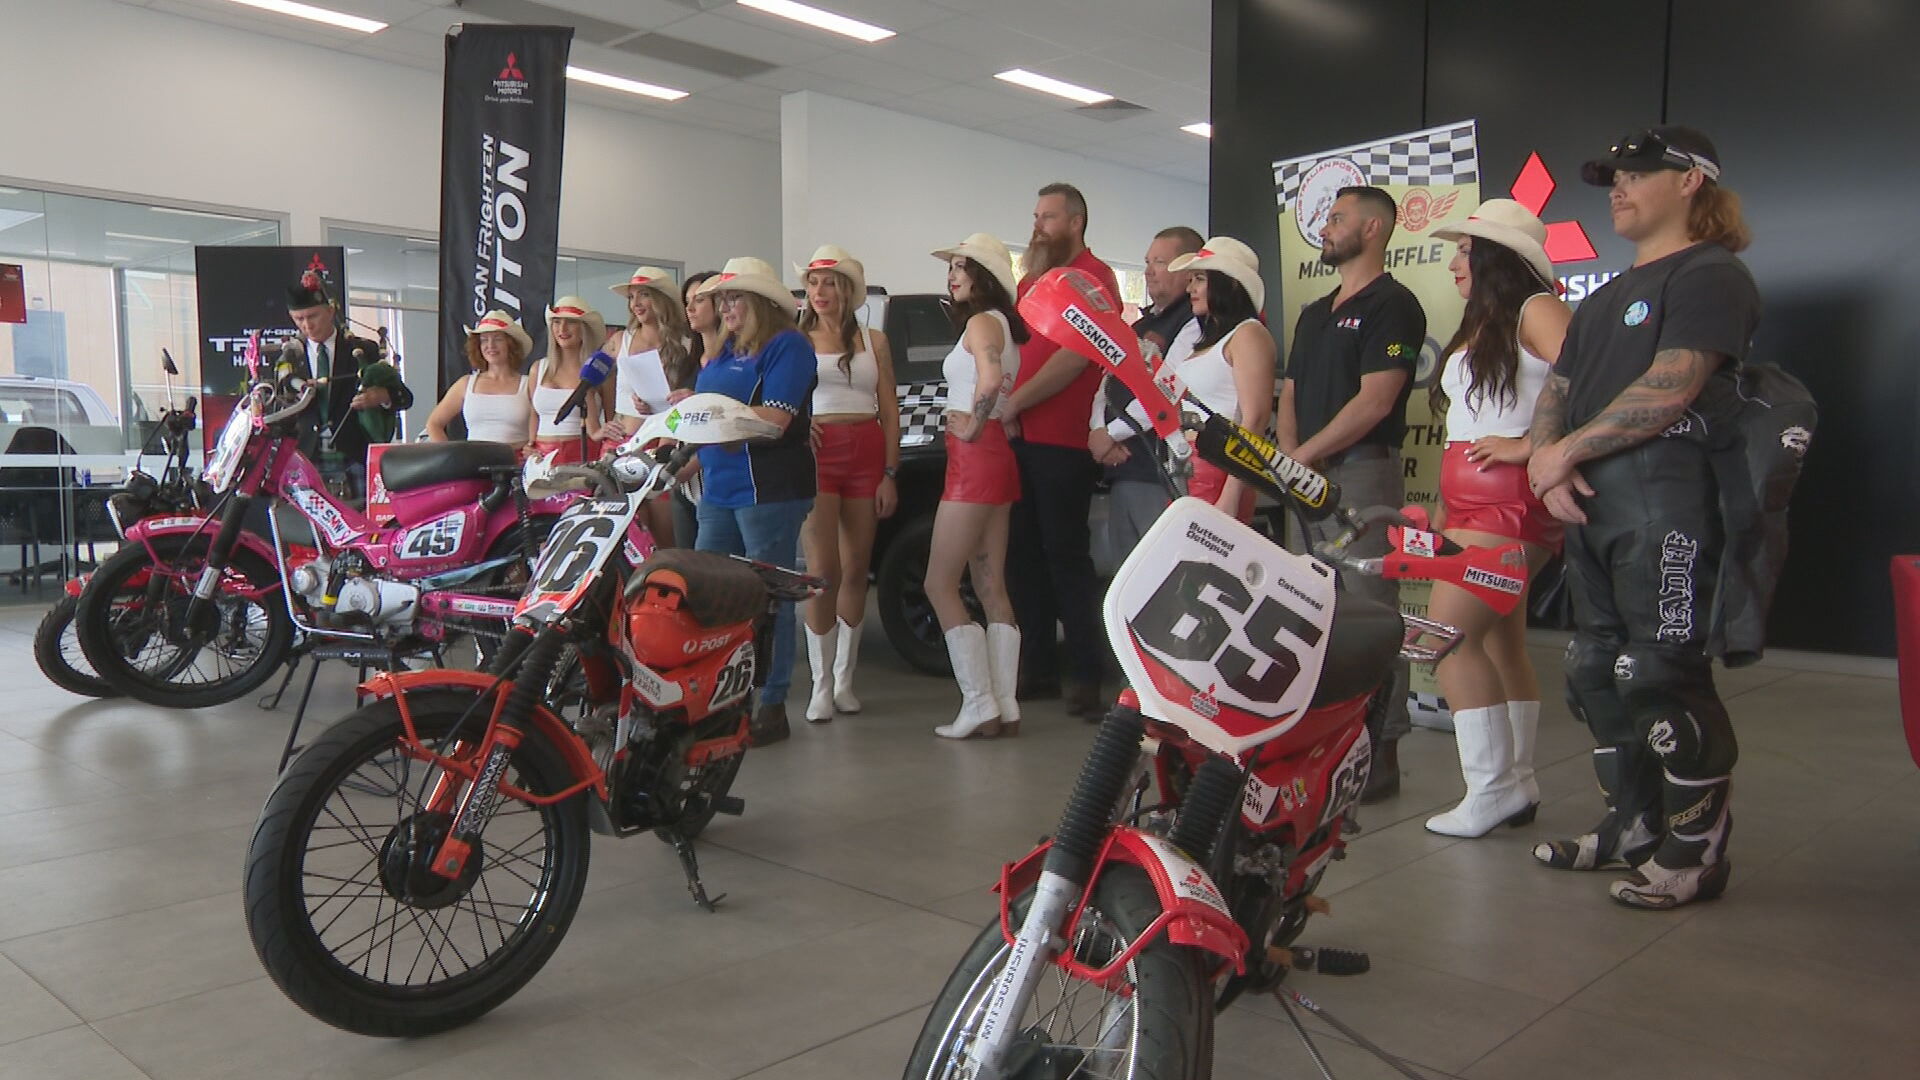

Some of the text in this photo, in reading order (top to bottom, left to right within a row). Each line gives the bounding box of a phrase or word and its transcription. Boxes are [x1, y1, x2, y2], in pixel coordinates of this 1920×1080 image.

[473, 133, 496, 317] CAN FRIGHTEN
[493, 140, 531, 312] ITON
[1383, 243, 1444, 269] AFFLE
[1064, 307, 1122, 364] CESSNOCK
[408, 526, 457, 556] 45
[1186, 529, 1229, 558] Octopus
[1189, 520, 1236, 552] Buttered
[700, 634, 732, 651] POST
[1129, 560, 1324, 704] 65
[713, 659, 753, 706] 26
[980, 936, 1029, 1041] MITSUBISHI
